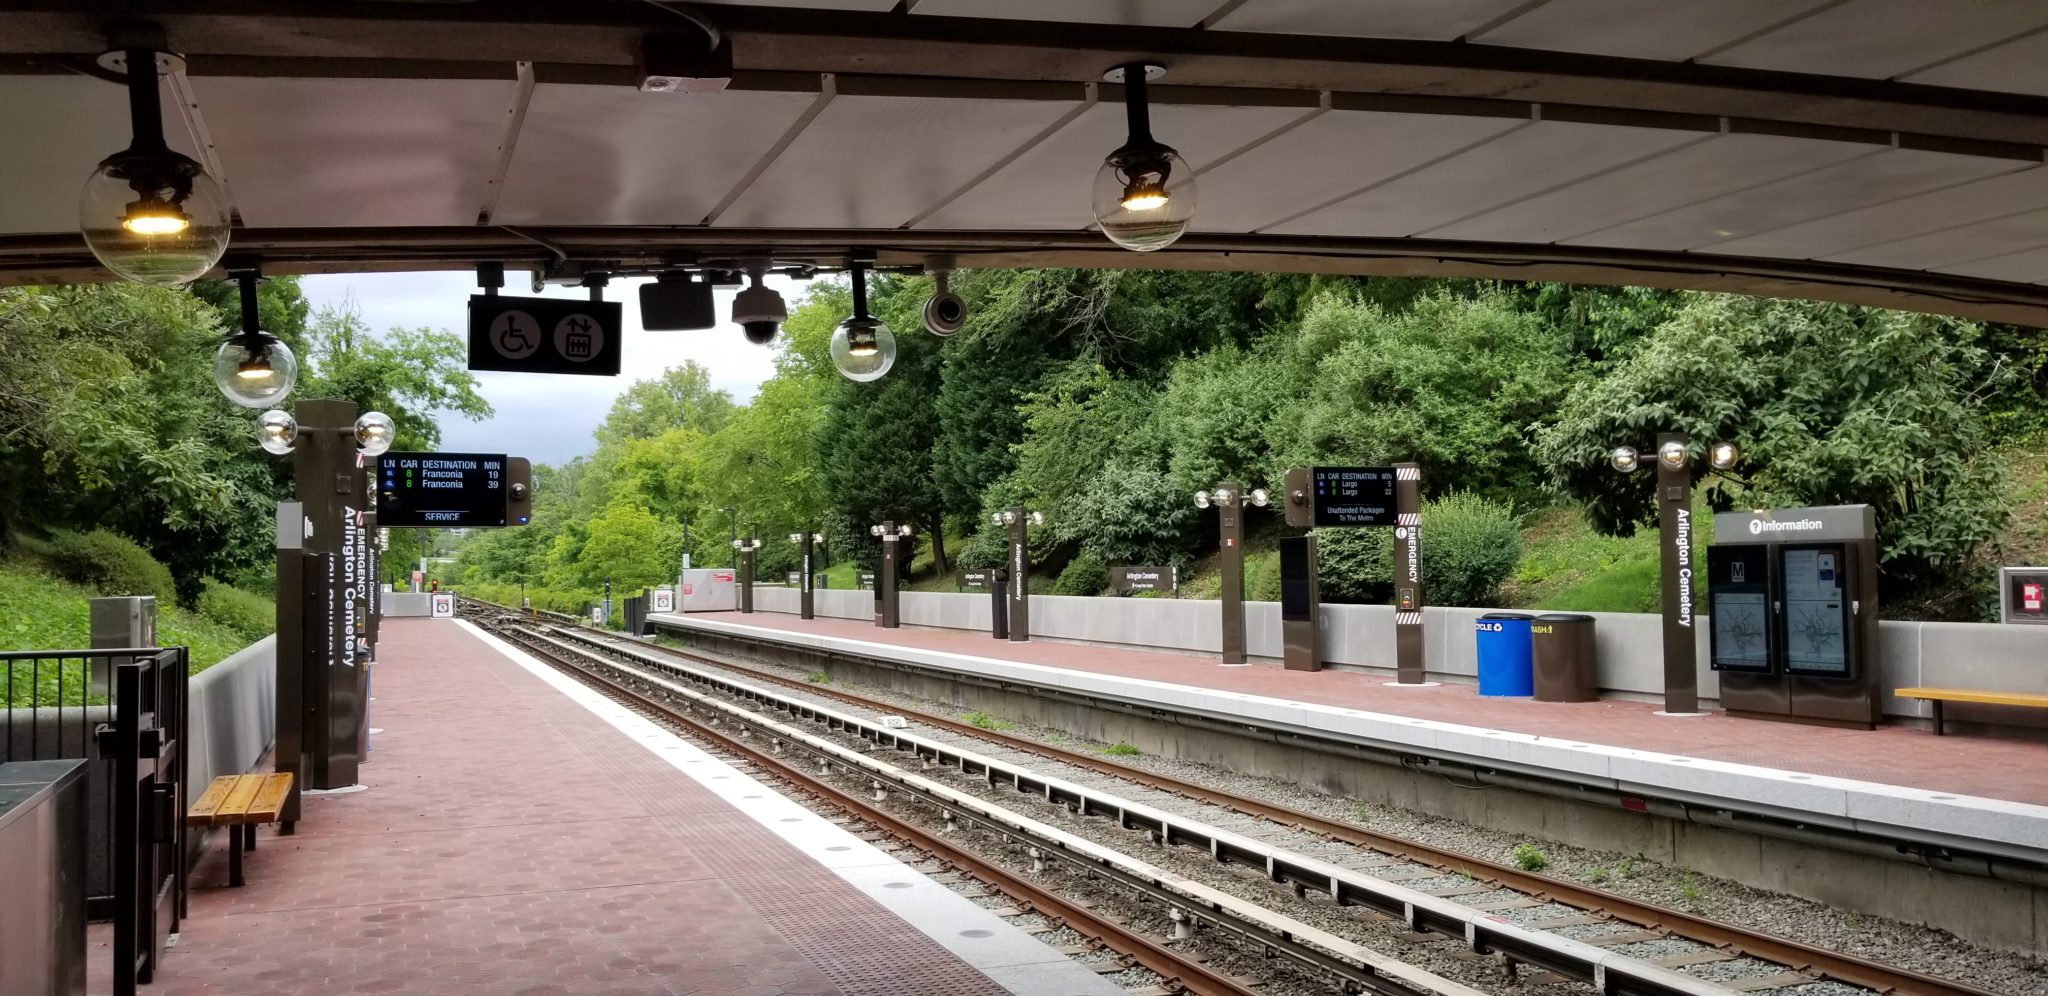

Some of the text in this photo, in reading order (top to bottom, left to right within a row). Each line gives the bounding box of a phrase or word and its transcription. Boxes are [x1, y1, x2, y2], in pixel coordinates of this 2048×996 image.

[384, 460, 500, 470] LN CAR DESTINATION MIN
[422, 470, 463, 478] Franconia
[488, 471, 498, 479] 19
[422, 480, 463, 488] Franconia
[488, 480, 499, 489] 39
[1360, 507, 1385, 515] Packages
[1763, 519, 1822, 531] Information
[1408, 527, 1417, 583] EMERGENCY
[357, 528, 365, 600] EMERGENCY
[1676, 509, 1692, 627] Arlington Cemetery
[342, 506, 356, 667] Arlington Cemetery
